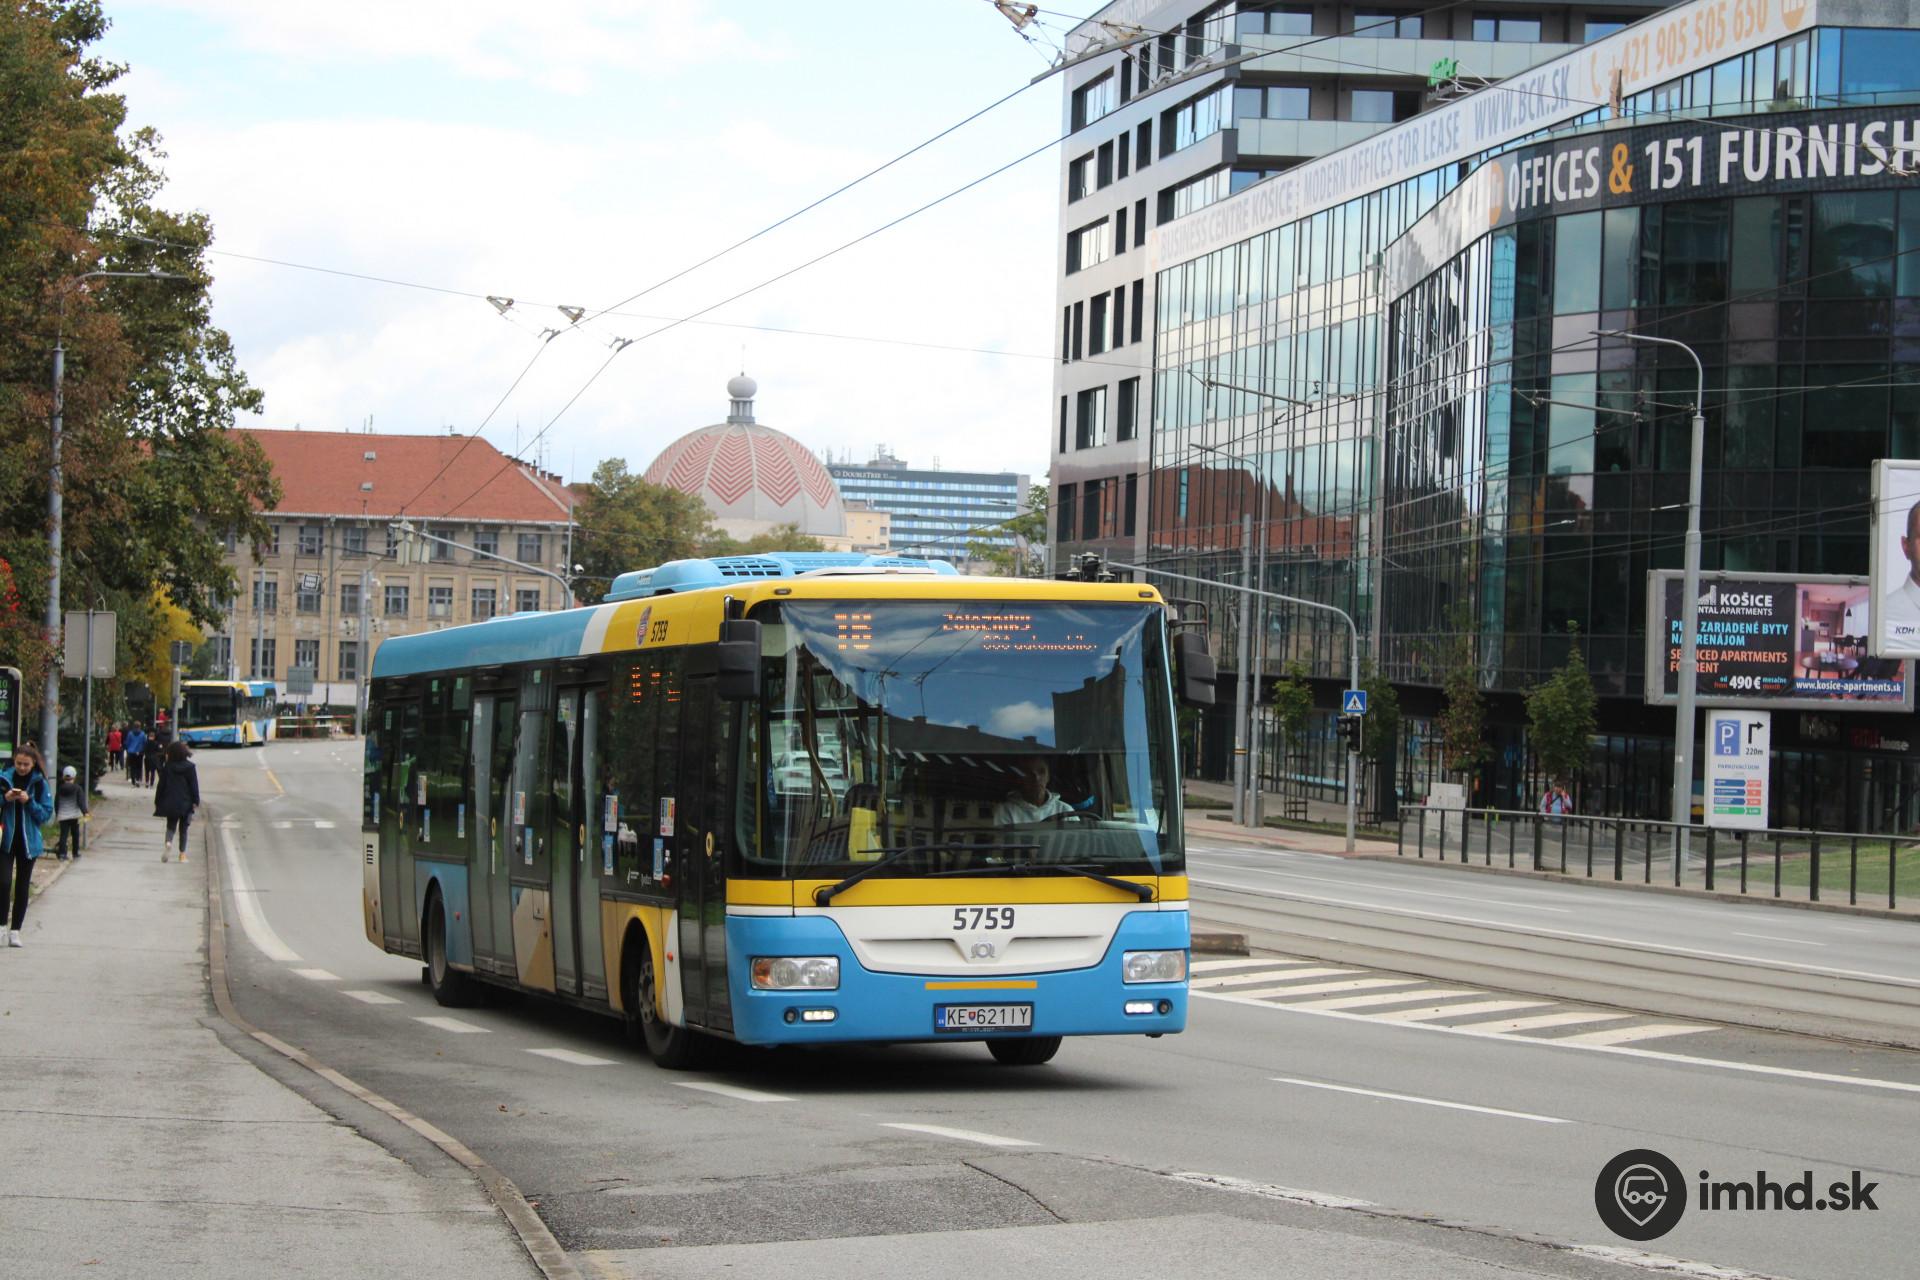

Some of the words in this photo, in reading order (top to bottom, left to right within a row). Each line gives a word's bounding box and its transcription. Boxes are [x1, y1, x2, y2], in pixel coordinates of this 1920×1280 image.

[1162, 215, 1208, 262] BUSINESS
[1208, 200, 1249, 242] CENTRE
[1304, 157, 1347, 207] MODERN
[1350, 137, 1393, 189] OFFICES
[1397, 127, 1419, 173] FOR
[1423, 110, 1460, 162] LEASE
[1474, 63, 1571, 142] WWW.BCK.SK
[1655, 16, 1688, 72] 905
[1693, 2, 1727, 58] 505
[1508, 147, 1600, 212] OFFICES
[1608, 143, 1634, 195] &
[1645, 136, 1703, 190] 151
[1719, 119, 1920, 184] FURNISH
[1720, 592, 1773, 607] KOŠICE
[1698, 606, 1719, 614] NTAL
[1720, 606, 1773, 616] APARTMENTS
[650, 620, 668, 643] 5759
[1700, 620, 1759, 634] ZARIADENÉ
[1762, 623, 1789, 635] BYTY
[1895, 626, 1915, 635] KDH
[1696, 631, 1745, 646] RENÁJOM
[1670, 648, 1718, 661] SEICED
[1720, 650, 1788, 663] APARTMENTS
[1796, 680, 1901, 693] www.kosice-apartments.sk
[1745, 747, 1763, 756] 220m
[952, 907, 1015, 931] 5759
